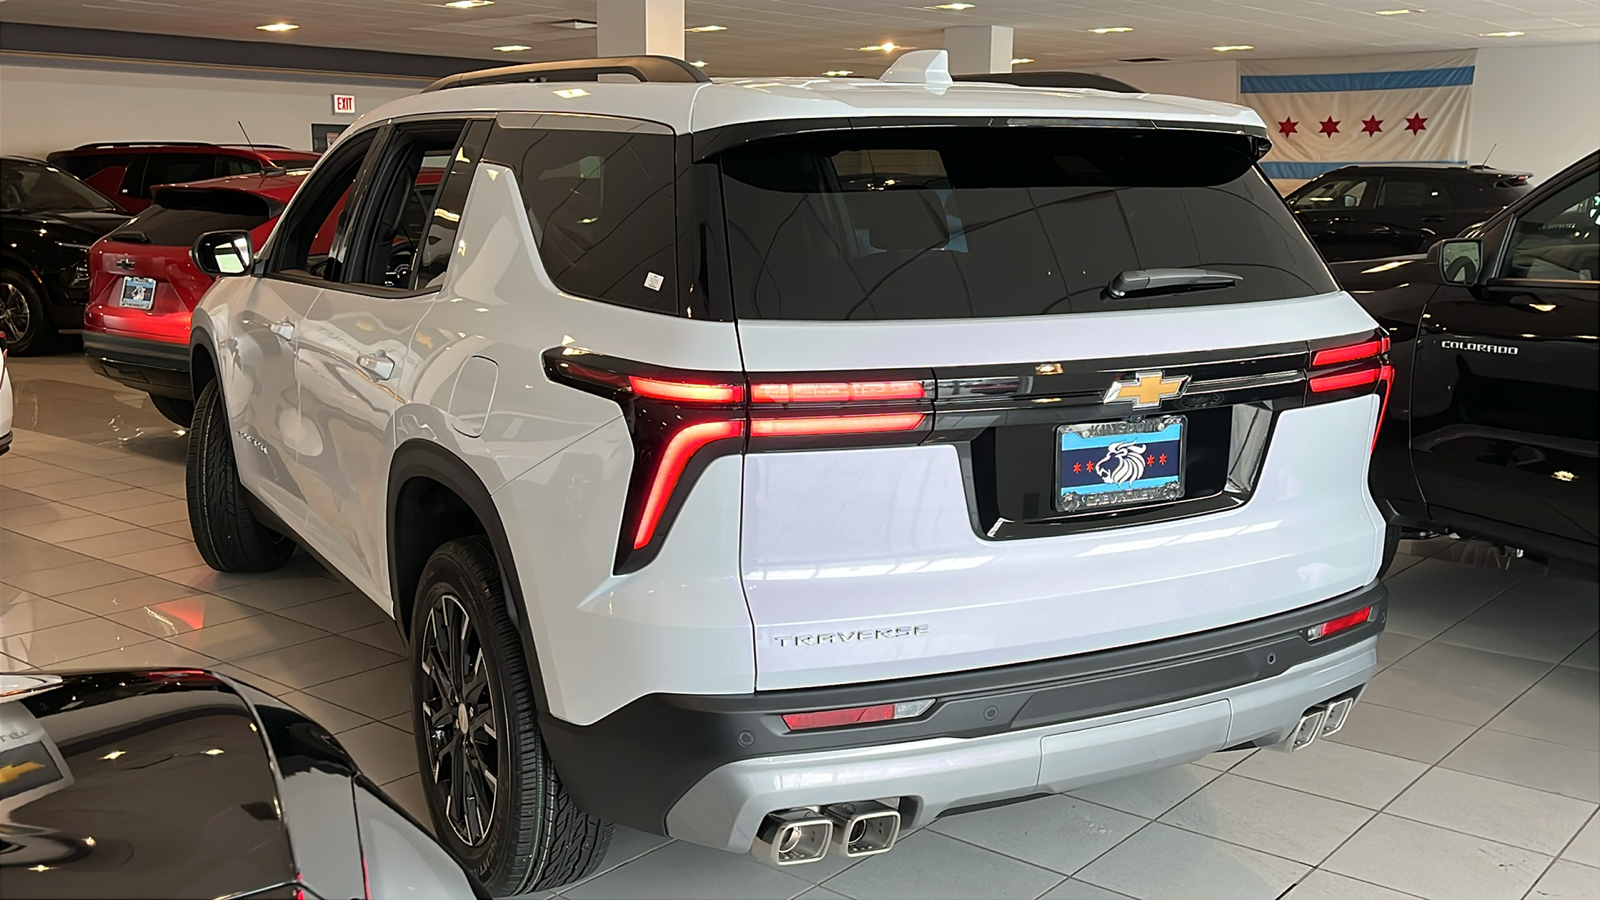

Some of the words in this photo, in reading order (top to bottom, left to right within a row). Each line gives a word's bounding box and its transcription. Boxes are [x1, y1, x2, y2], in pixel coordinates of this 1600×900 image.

[337, 97, 353, 110] EXIT
[1441, 340, 1519, 355] COLORADO
[774, 624, 930, 647] TRAVERSE
